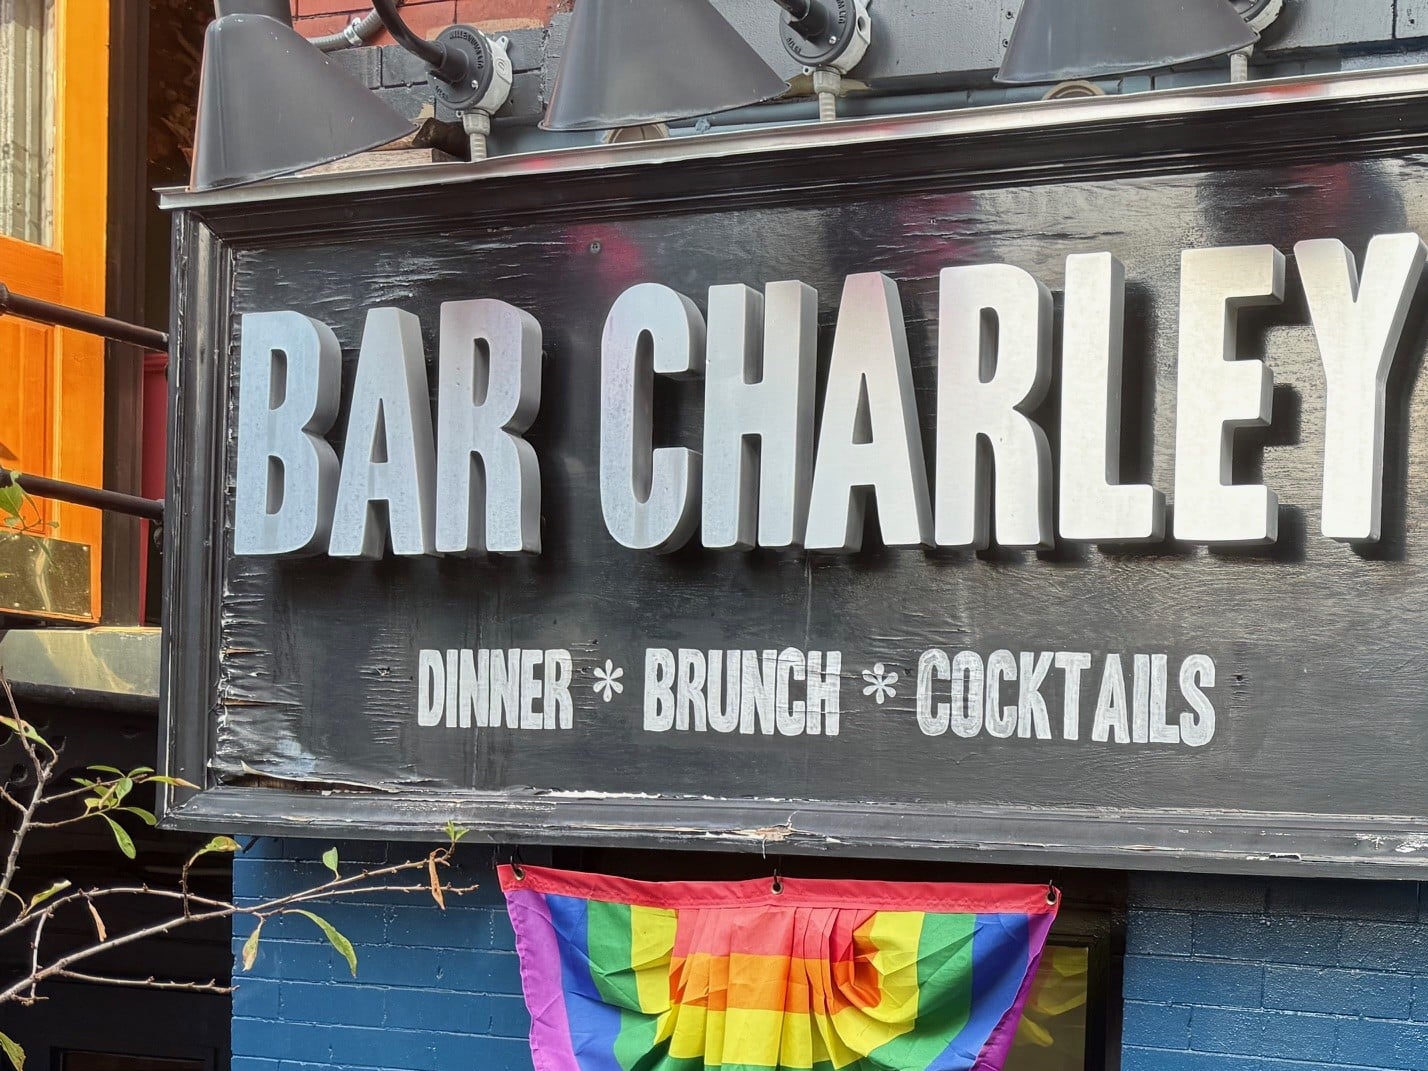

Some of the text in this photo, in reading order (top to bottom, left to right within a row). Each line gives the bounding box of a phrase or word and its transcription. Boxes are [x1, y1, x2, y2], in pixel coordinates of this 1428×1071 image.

[234, 232, 1428, 558] BAR CHARLEY
[417, 646, 1216, 747] DINNER BRUNCH COCKTAILS
